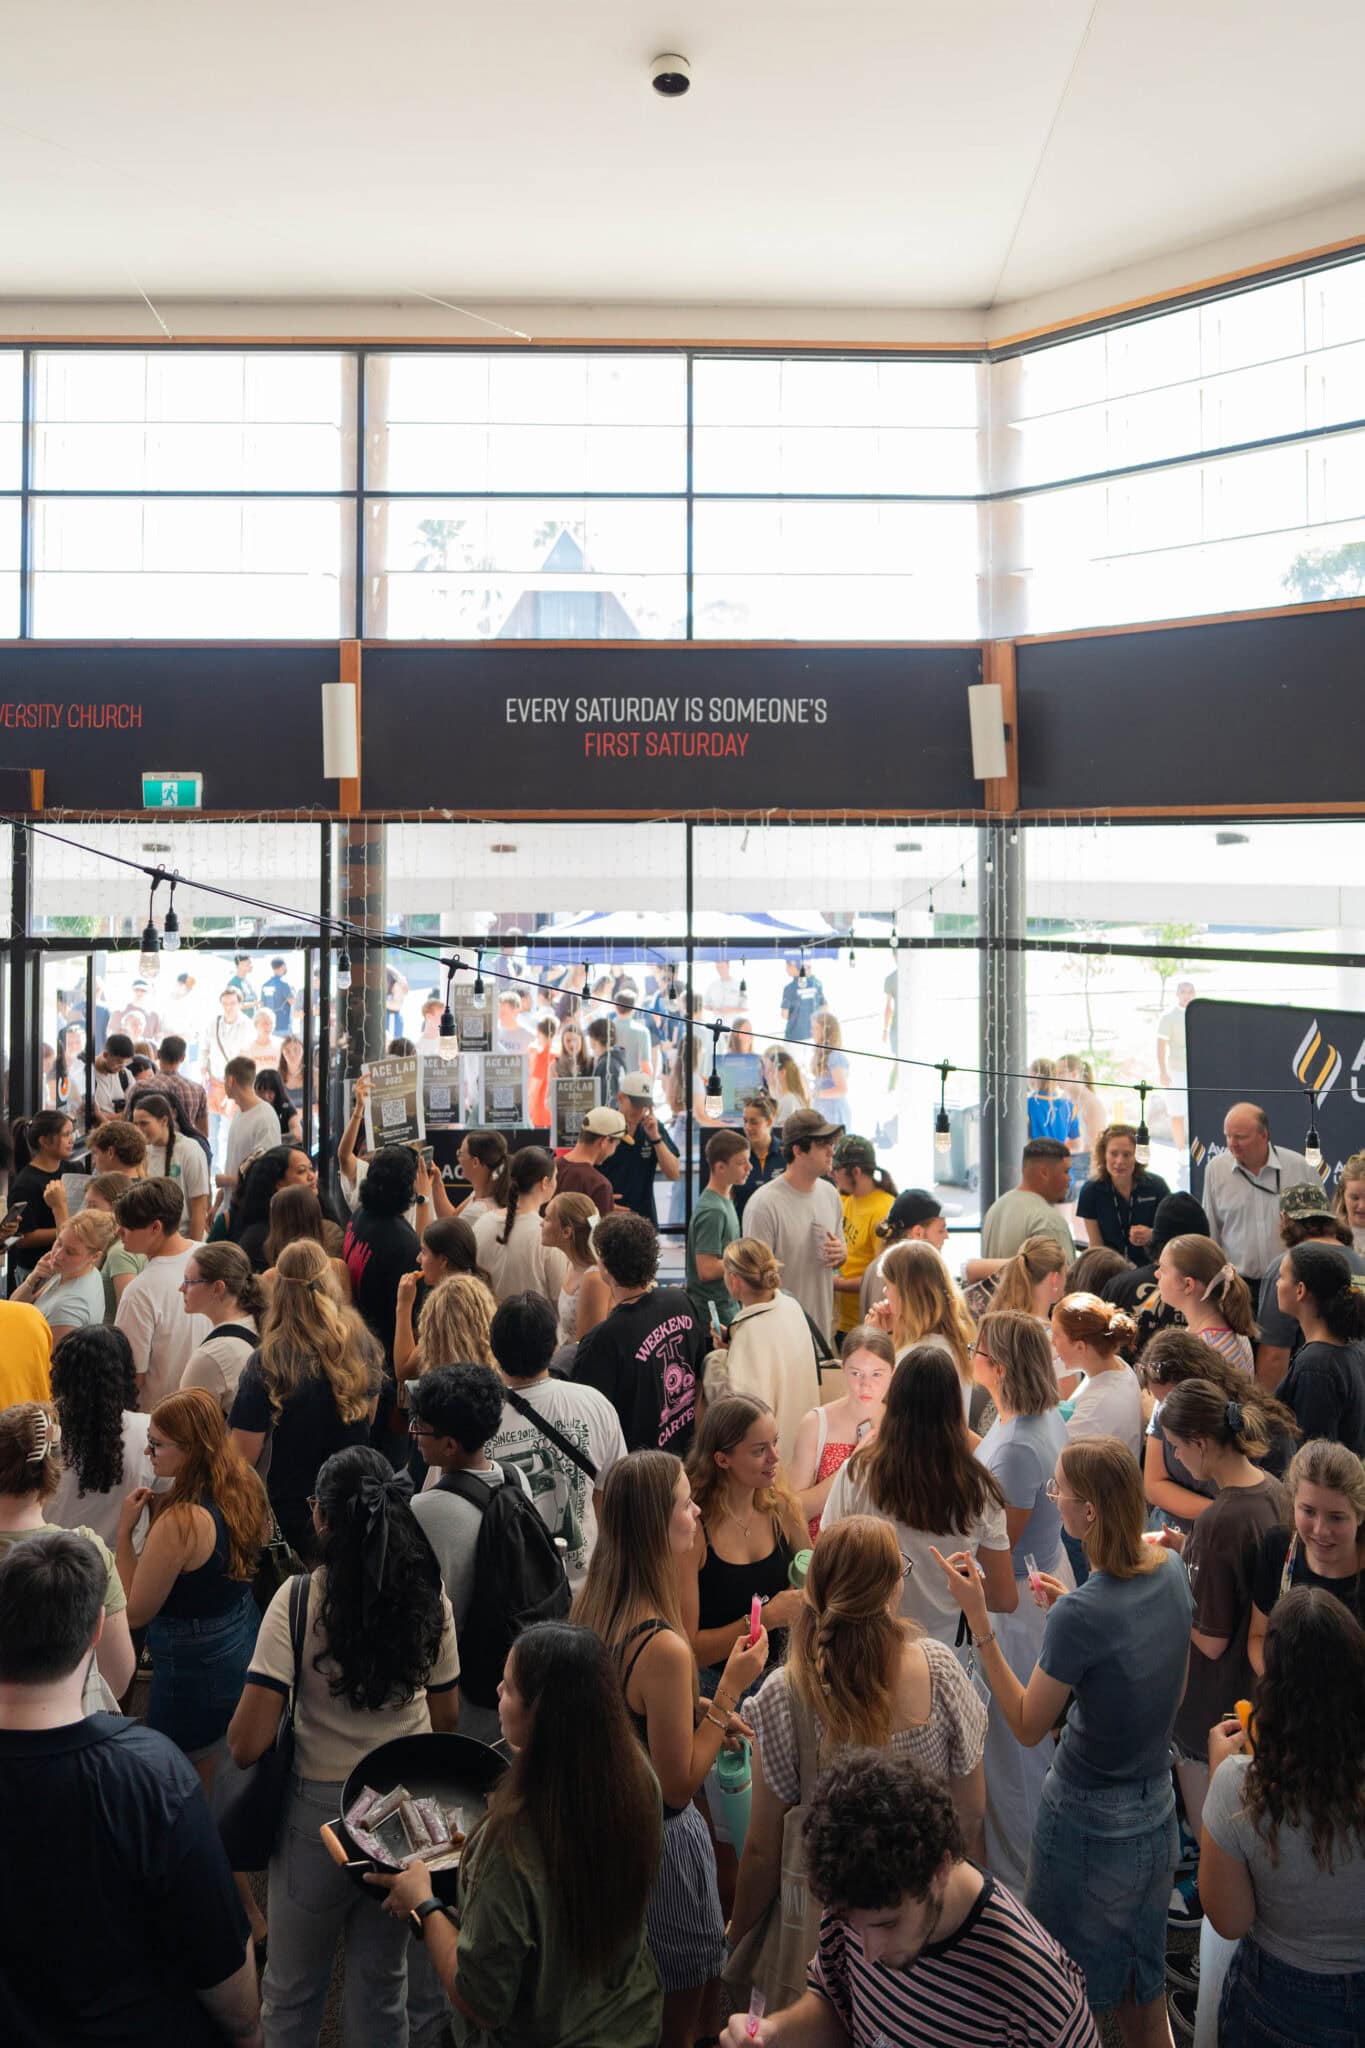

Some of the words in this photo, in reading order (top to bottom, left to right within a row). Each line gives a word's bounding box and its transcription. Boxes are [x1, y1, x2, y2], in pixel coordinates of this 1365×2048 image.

[67, 703, 142, 728] CHURCH
[506, 698, 570, 723] EVERY
[575, 697, 679, 722] SATURDAY
[685, 697, 703, 722] IS
[709, 698, 828, 723] SOMEONE'S
[585, 732, 641, 757] FIRST
[645, 732, 750, 757] SATURDAY
[372, 1063, 392, 1078] ACE
[396, 1061, 416, 1074] LAB
[485, 1058, 502, 1068] ACE
[504, 1058, 521, 1067] LAB
[558, 1082, 574, 1091] ACE
[576, 1082, 593, 1091] LAB
[634, 1314, 693, 1363] WEEKEND
[493, 1431, 518, 1447] SINCE
